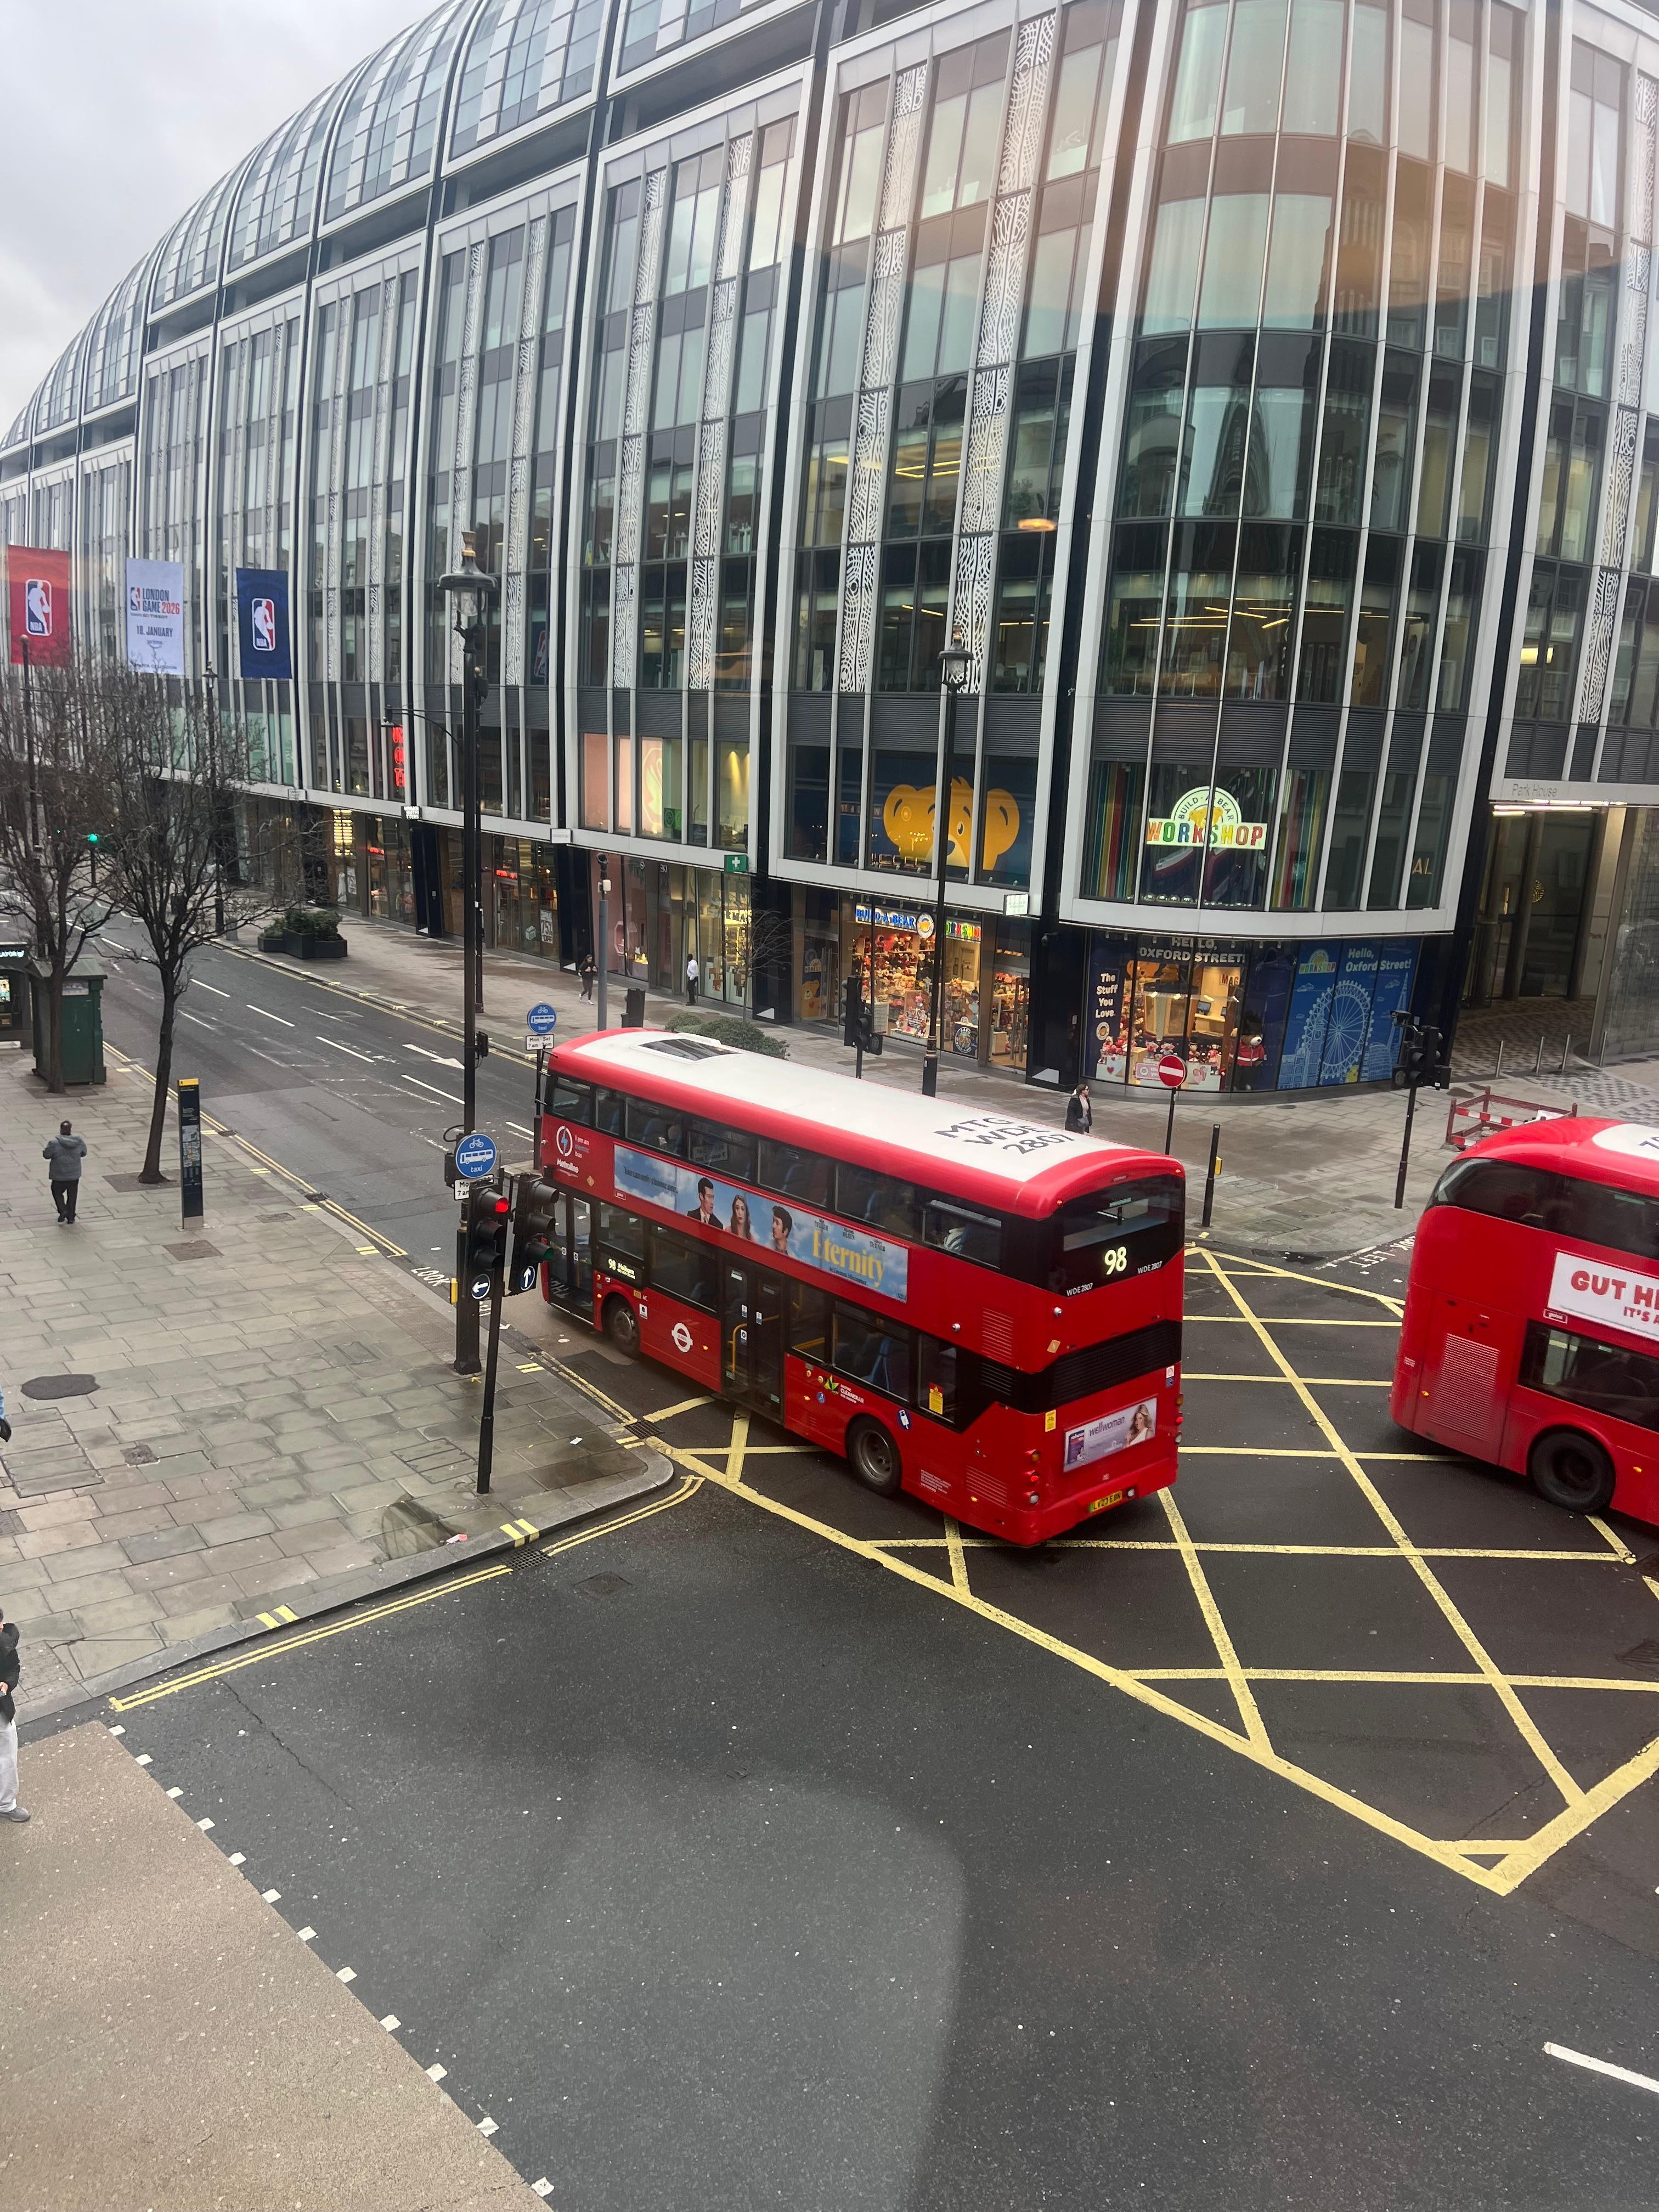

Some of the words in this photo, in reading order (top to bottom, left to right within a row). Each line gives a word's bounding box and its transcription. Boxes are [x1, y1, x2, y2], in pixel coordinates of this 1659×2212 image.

[143, 588, 169, 601] LONDON
[143, 600, 160, 613] GAME
[162, 602, 180, 614] 2026
[30, 622, 43, 631] NBA
[146, 626, 173, 637] JANUARY
[256, 637, 267, 647] NBA
[1511, 783, 1531, 796] Park
[1532, 783, 1558, 797] House
[1147, 821, 1263, 846] WORKSHOP
[855, 908, 916, 930] BUID-A-BEAR
[1139, 947, 1190, 961] OXFORD
[1194, 952, 1245, 963] STREET!
[1348, 947, 1374, 959] Hello,
[1346, 960, 1379, 973] Oxford
[1380, 958, 1412, 970] Street!
[1101, 973, 1115, 982] The
[1096, 984, 1119, 995] Stuff
[1098, 997, 1113, 1007] You
[934, 1118, 1014, 1138] MTG
[963, 1126, 1050, 1144] WDE
[1002, 1134, 1075, 1154] 2807
[813, 1230, 885, 1288] Eternity
[1104, 1246, 1127, 1275] 98
[1348, 1250, 1396, 1268] LEFT
[1137, 1264, 1151, 1274] WDE
[1151, 1261, 1163, 1270] 2807
[410, 1266, 452, 1287] LOOK
[1066, 1286, 1081, 1296] WDE
[1081, 1282, 1093, 1292] 2807
[1571, 1270, 1627, 1300] GUT
[1623, 1306, 1651, 1323] IT'S
[1089, 1417, 1125, 1437] wellwoman
